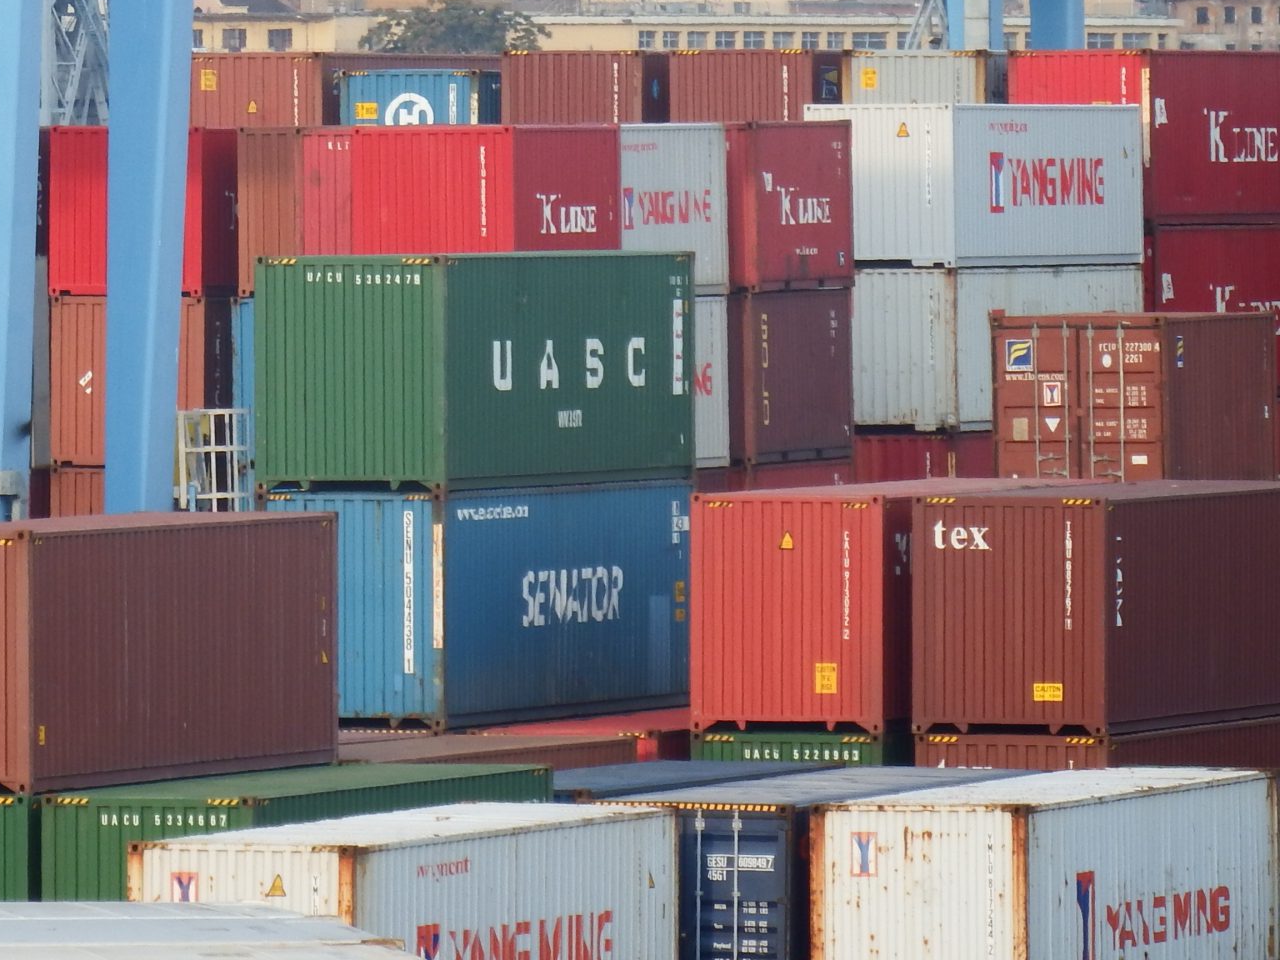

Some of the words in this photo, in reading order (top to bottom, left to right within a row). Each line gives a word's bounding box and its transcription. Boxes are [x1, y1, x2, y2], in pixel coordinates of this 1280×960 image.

[1232, 127, 1279, 163] LINE
[1007, 158, 1057, 206] YANG
[1059, 157, 1105, 205] MING
[561, 206, 597, 233] LINE
[493, 336, 646, 390] UASC
[1125, 342, 1152, 352] 227300
[694, 362, 713, 396] NG
[933, 520, 990, 550] tex
[522, 565, 624, 628] SENATOR
[101, 814, 139, 826] UACU
[707, 856, 727, 868] GESU
[1173, 885, 1231, 940] MING
